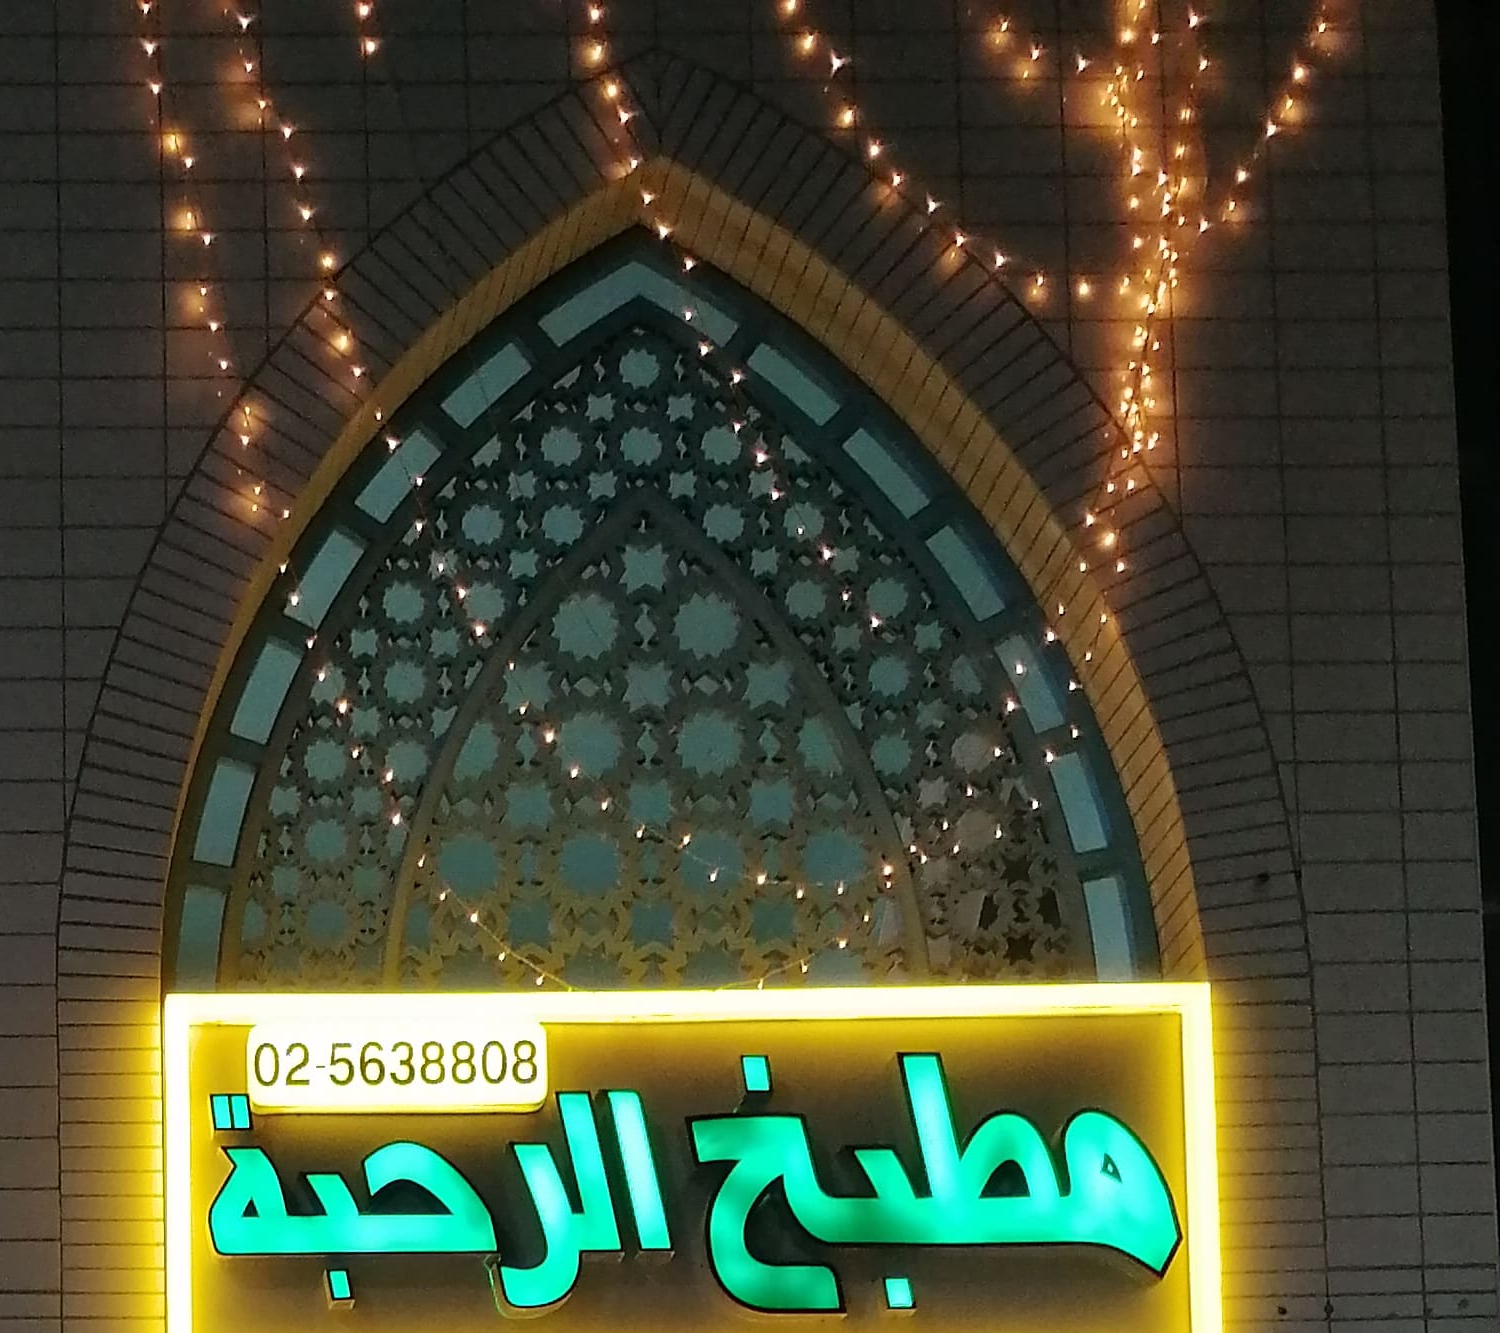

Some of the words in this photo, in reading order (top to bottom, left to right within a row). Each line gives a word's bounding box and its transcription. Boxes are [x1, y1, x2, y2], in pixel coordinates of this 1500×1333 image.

[252, 1038, 540, 1088] 02-5638808
[208, 1089, 674, 1315] الرحبة
[687, 1050, 1184, 1315] مطبخ
